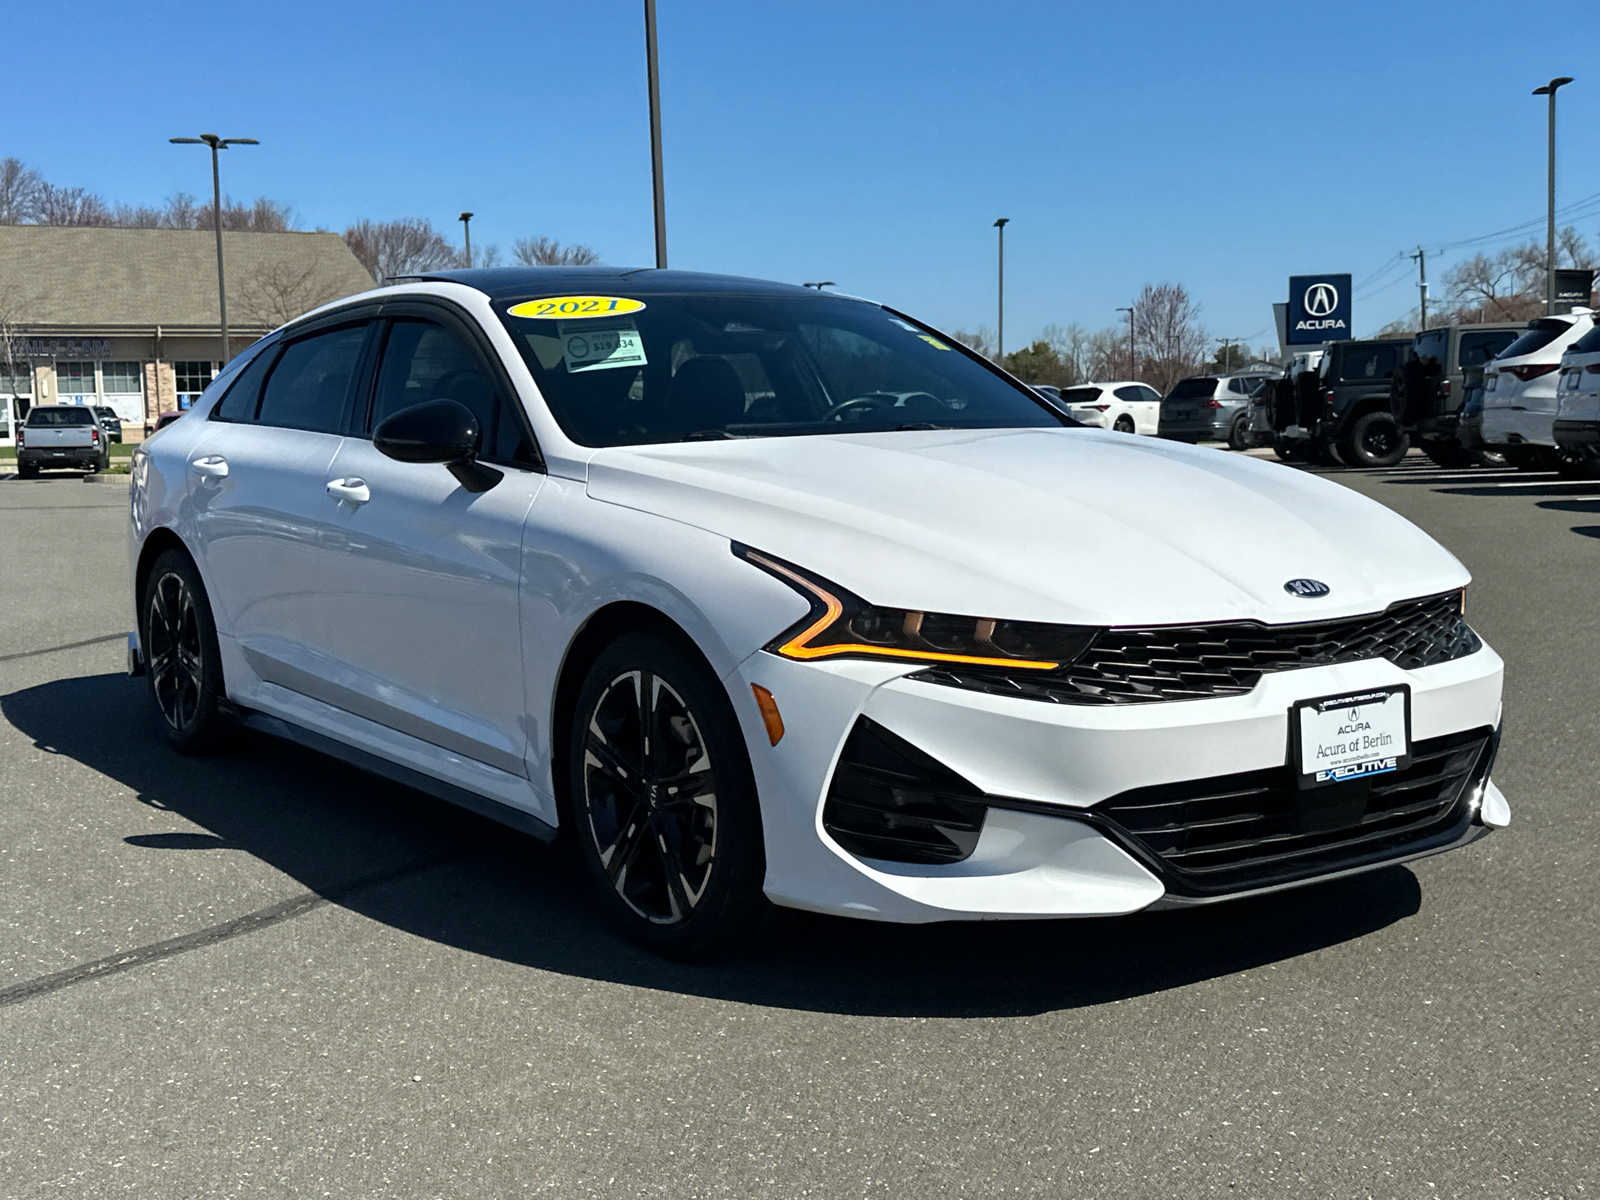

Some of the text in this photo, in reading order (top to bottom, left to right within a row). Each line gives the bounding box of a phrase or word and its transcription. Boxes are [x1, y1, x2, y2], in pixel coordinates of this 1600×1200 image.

[536, 300, 618, 315] 2021
[1295, 319, 1346, 331] ACURA
[11, 340, 113, 360] AILS & SPA
[1289, 580, 1328, 594] KIA
[1338, 722, 1371, 735] ACURA
[1316, 732, 1392, 758] Acura of Berlin
[1316, 757, 1397, 782] EXECUTIVE
[650, 785, 658, 807] KIA
